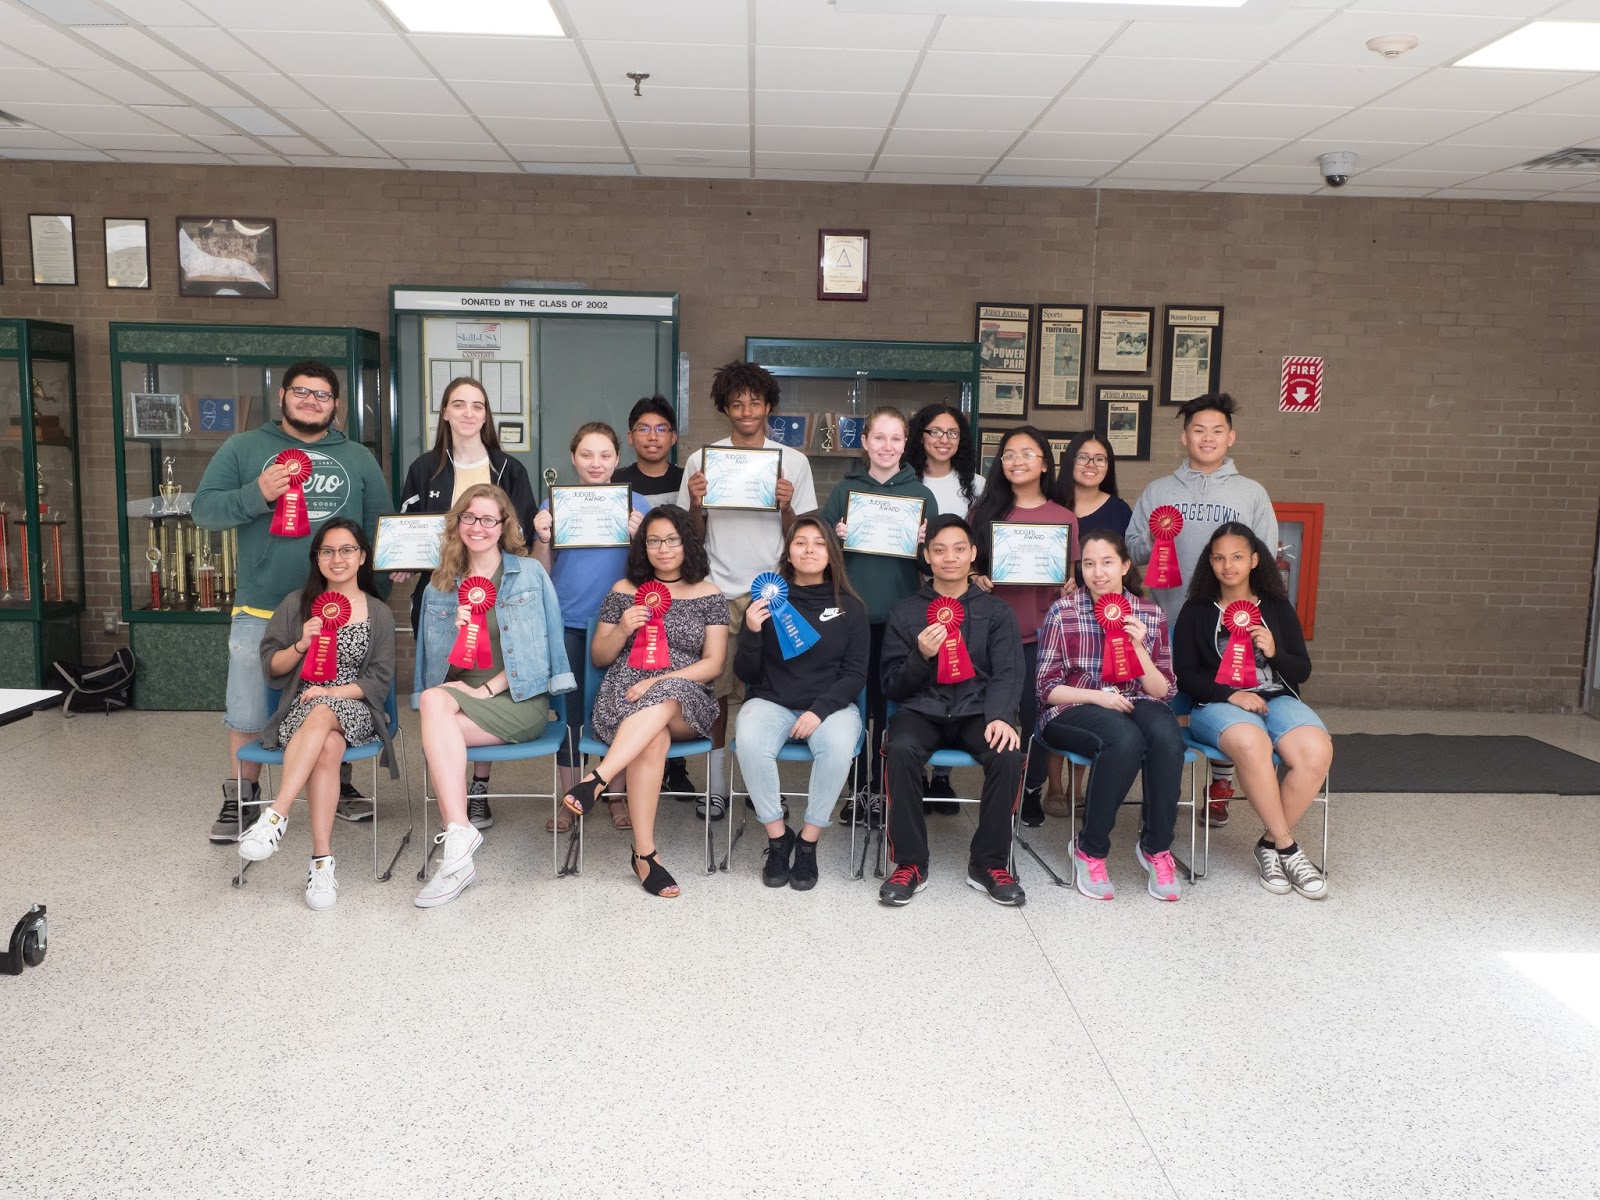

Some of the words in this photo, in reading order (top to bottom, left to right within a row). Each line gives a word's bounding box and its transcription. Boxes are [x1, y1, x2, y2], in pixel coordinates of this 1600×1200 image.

[461, 298, 500, 306] DONATED
[504, 299, 516, 307] BY
[519, 299, 535, 307] THE
[539, 300, 568, 308] CLASS
[586, 301, 608, 309] 2002
[1043, 310, 1063, 319] Sports
[993, 348, 1025, 358] POWER
[1003, 359, 1025, 369] PAIR
[1290, 365, 1316, 375] FIRE
[302, 473, 345, 493] ero
[869, 499, 891, 507] JUDGES
[1170, 503, 1240, 523] RGETOWN
[823, 607, 840, 616] NIKE
